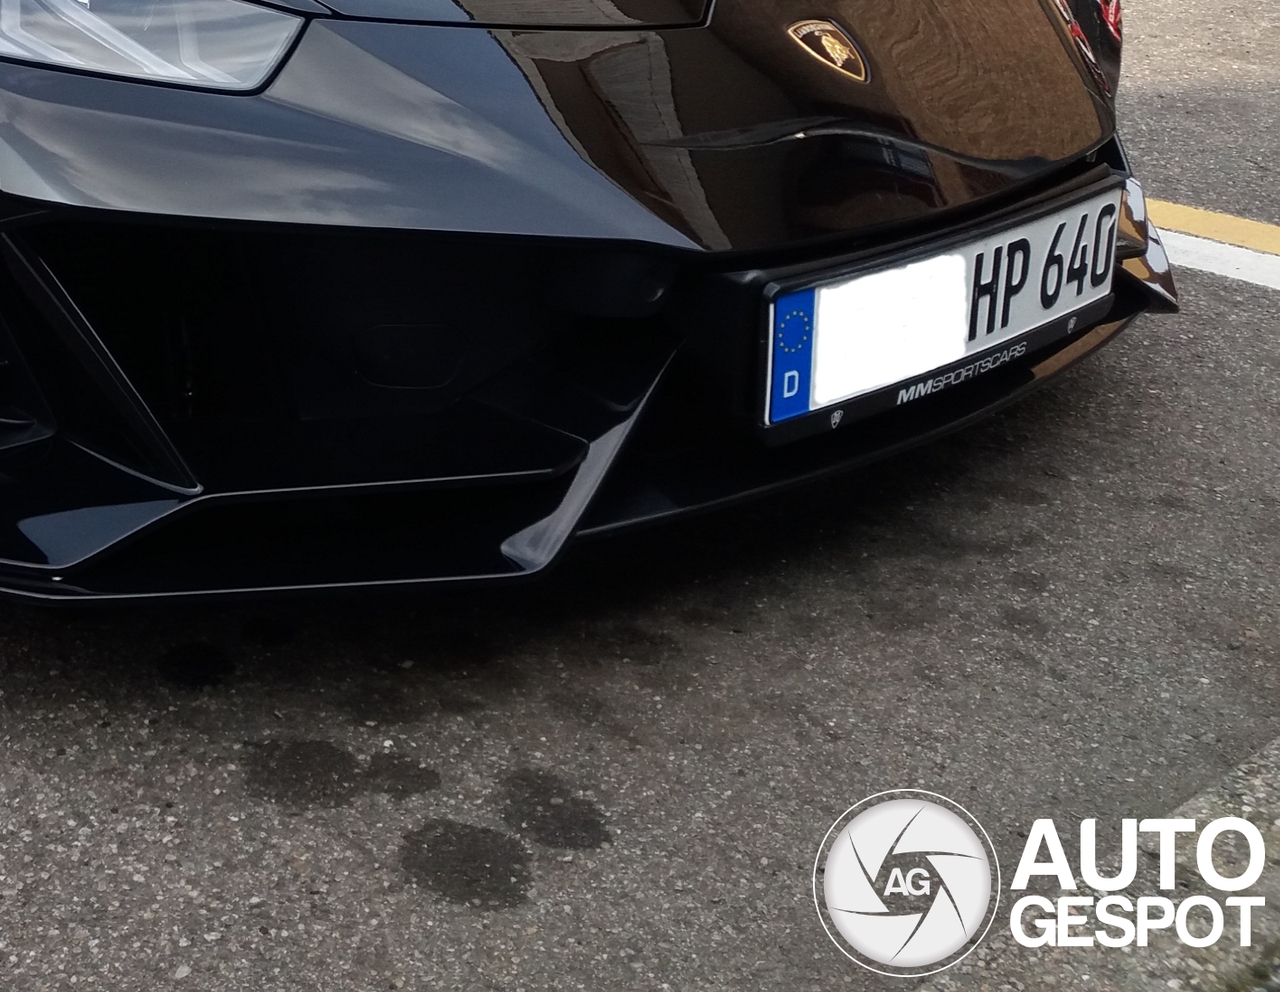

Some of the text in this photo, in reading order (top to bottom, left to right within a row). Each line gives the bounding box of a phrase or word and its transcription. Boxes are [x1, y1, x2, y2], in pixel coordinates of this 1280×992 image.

[967, 202, 1117, 342] HP 640
[783, 370, 800, 398] D
